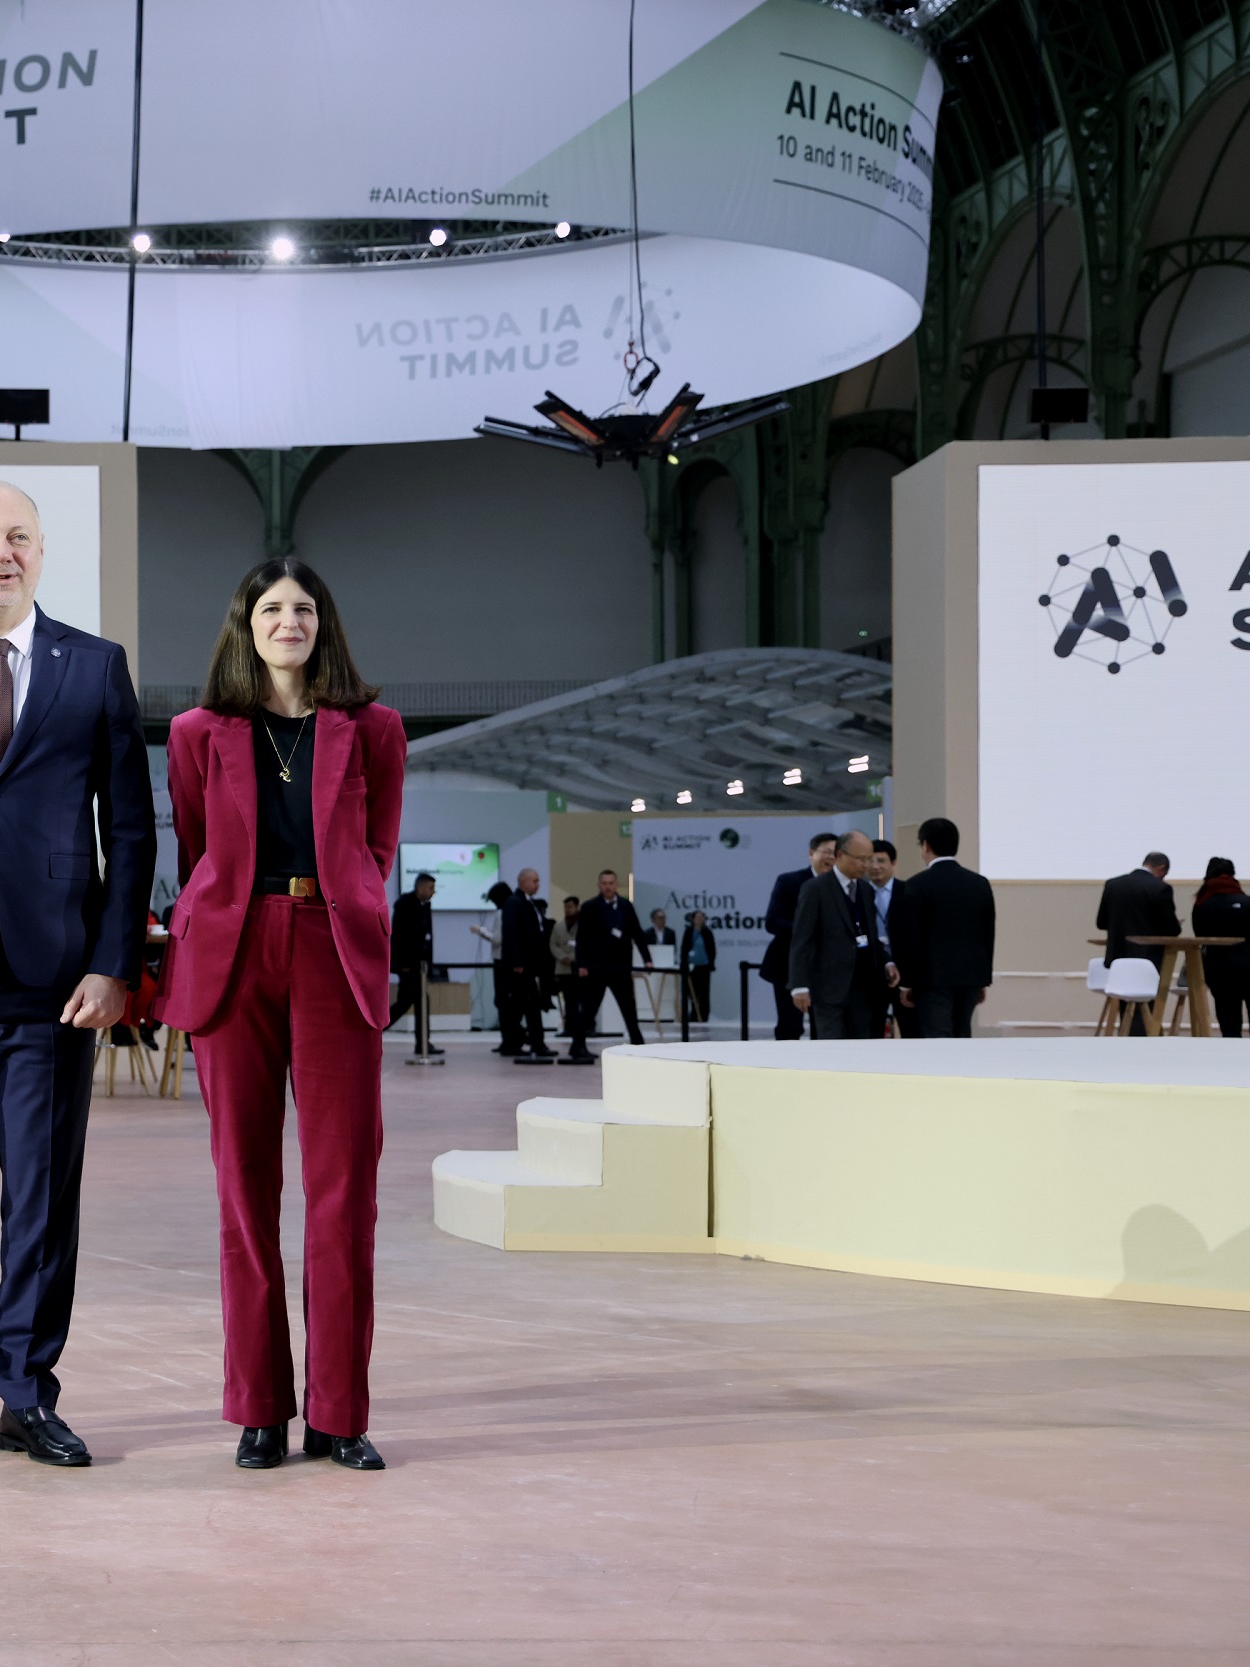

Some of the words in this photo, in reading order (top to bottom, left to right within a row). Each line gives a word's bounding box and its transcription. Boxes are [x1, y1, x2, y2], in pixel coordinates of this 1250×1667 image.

[785, 80, 816, 121] AI
[825, 90, 898, 151] Action
[777, 133, 798, 158] 10
[804, 144, 836, 168] and
[840, 149, 853, 174] 11
[857, 156, 907, 203] February
[368, 186, 550, 208] #AIActionSummit
[665, 889, 735, 910] Action
[684, 911, 767, 930] Sation
